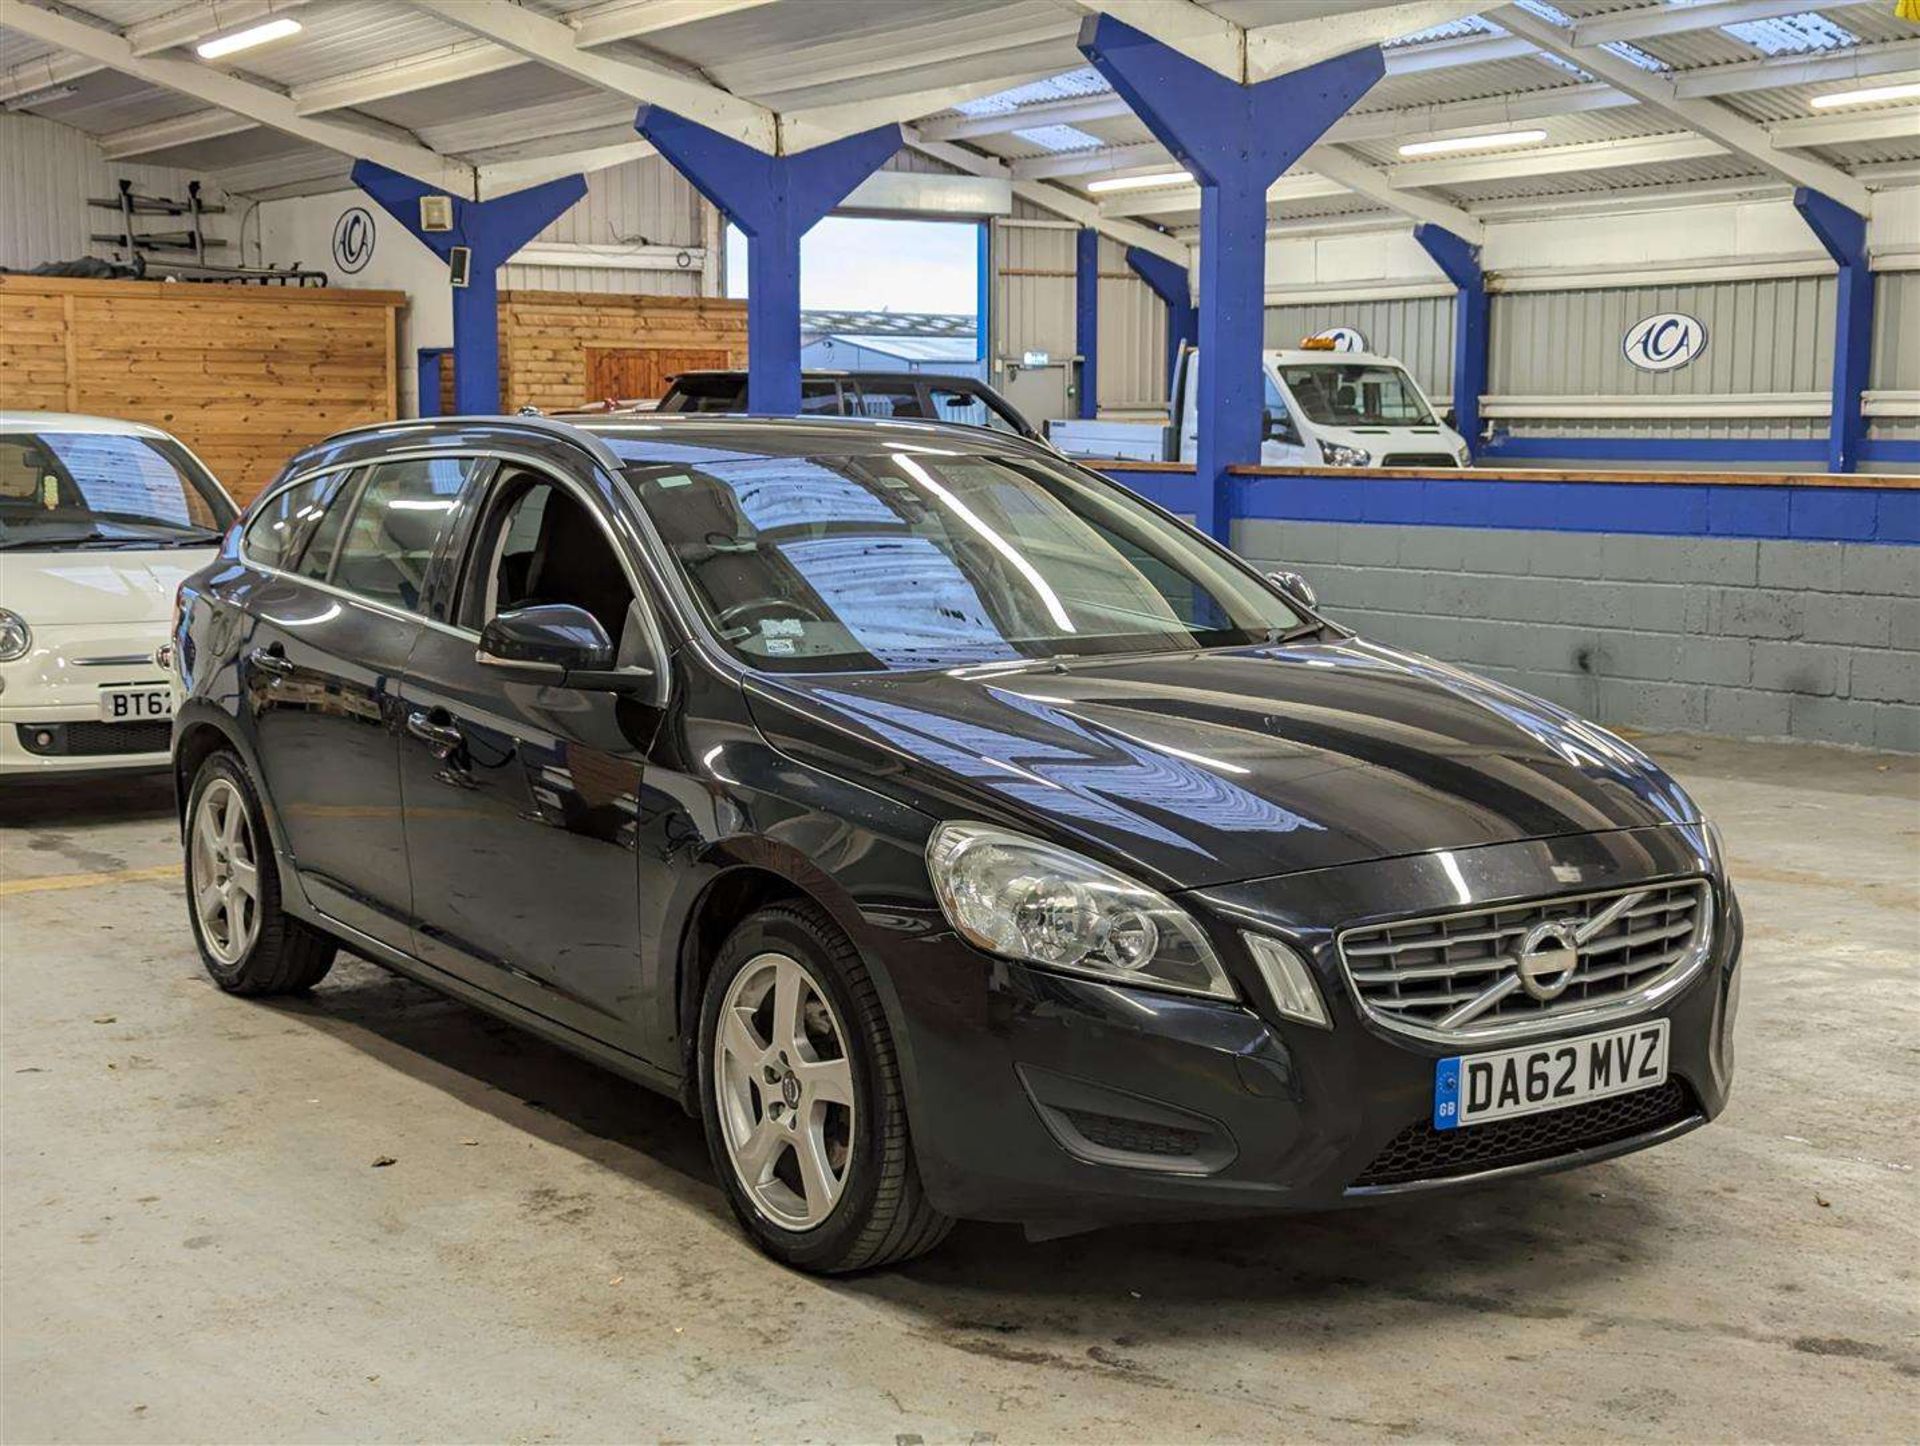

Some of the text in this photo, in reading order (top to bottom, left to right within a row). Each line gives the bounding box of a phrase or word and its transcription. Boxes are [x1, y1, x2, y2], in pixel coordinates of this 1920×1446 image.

[1628, 319, 1690, 362] ACA
[1467, 1028, 1661, 1114] DA62 MVZ
[1439, 1101, 1456, 1117] GB
